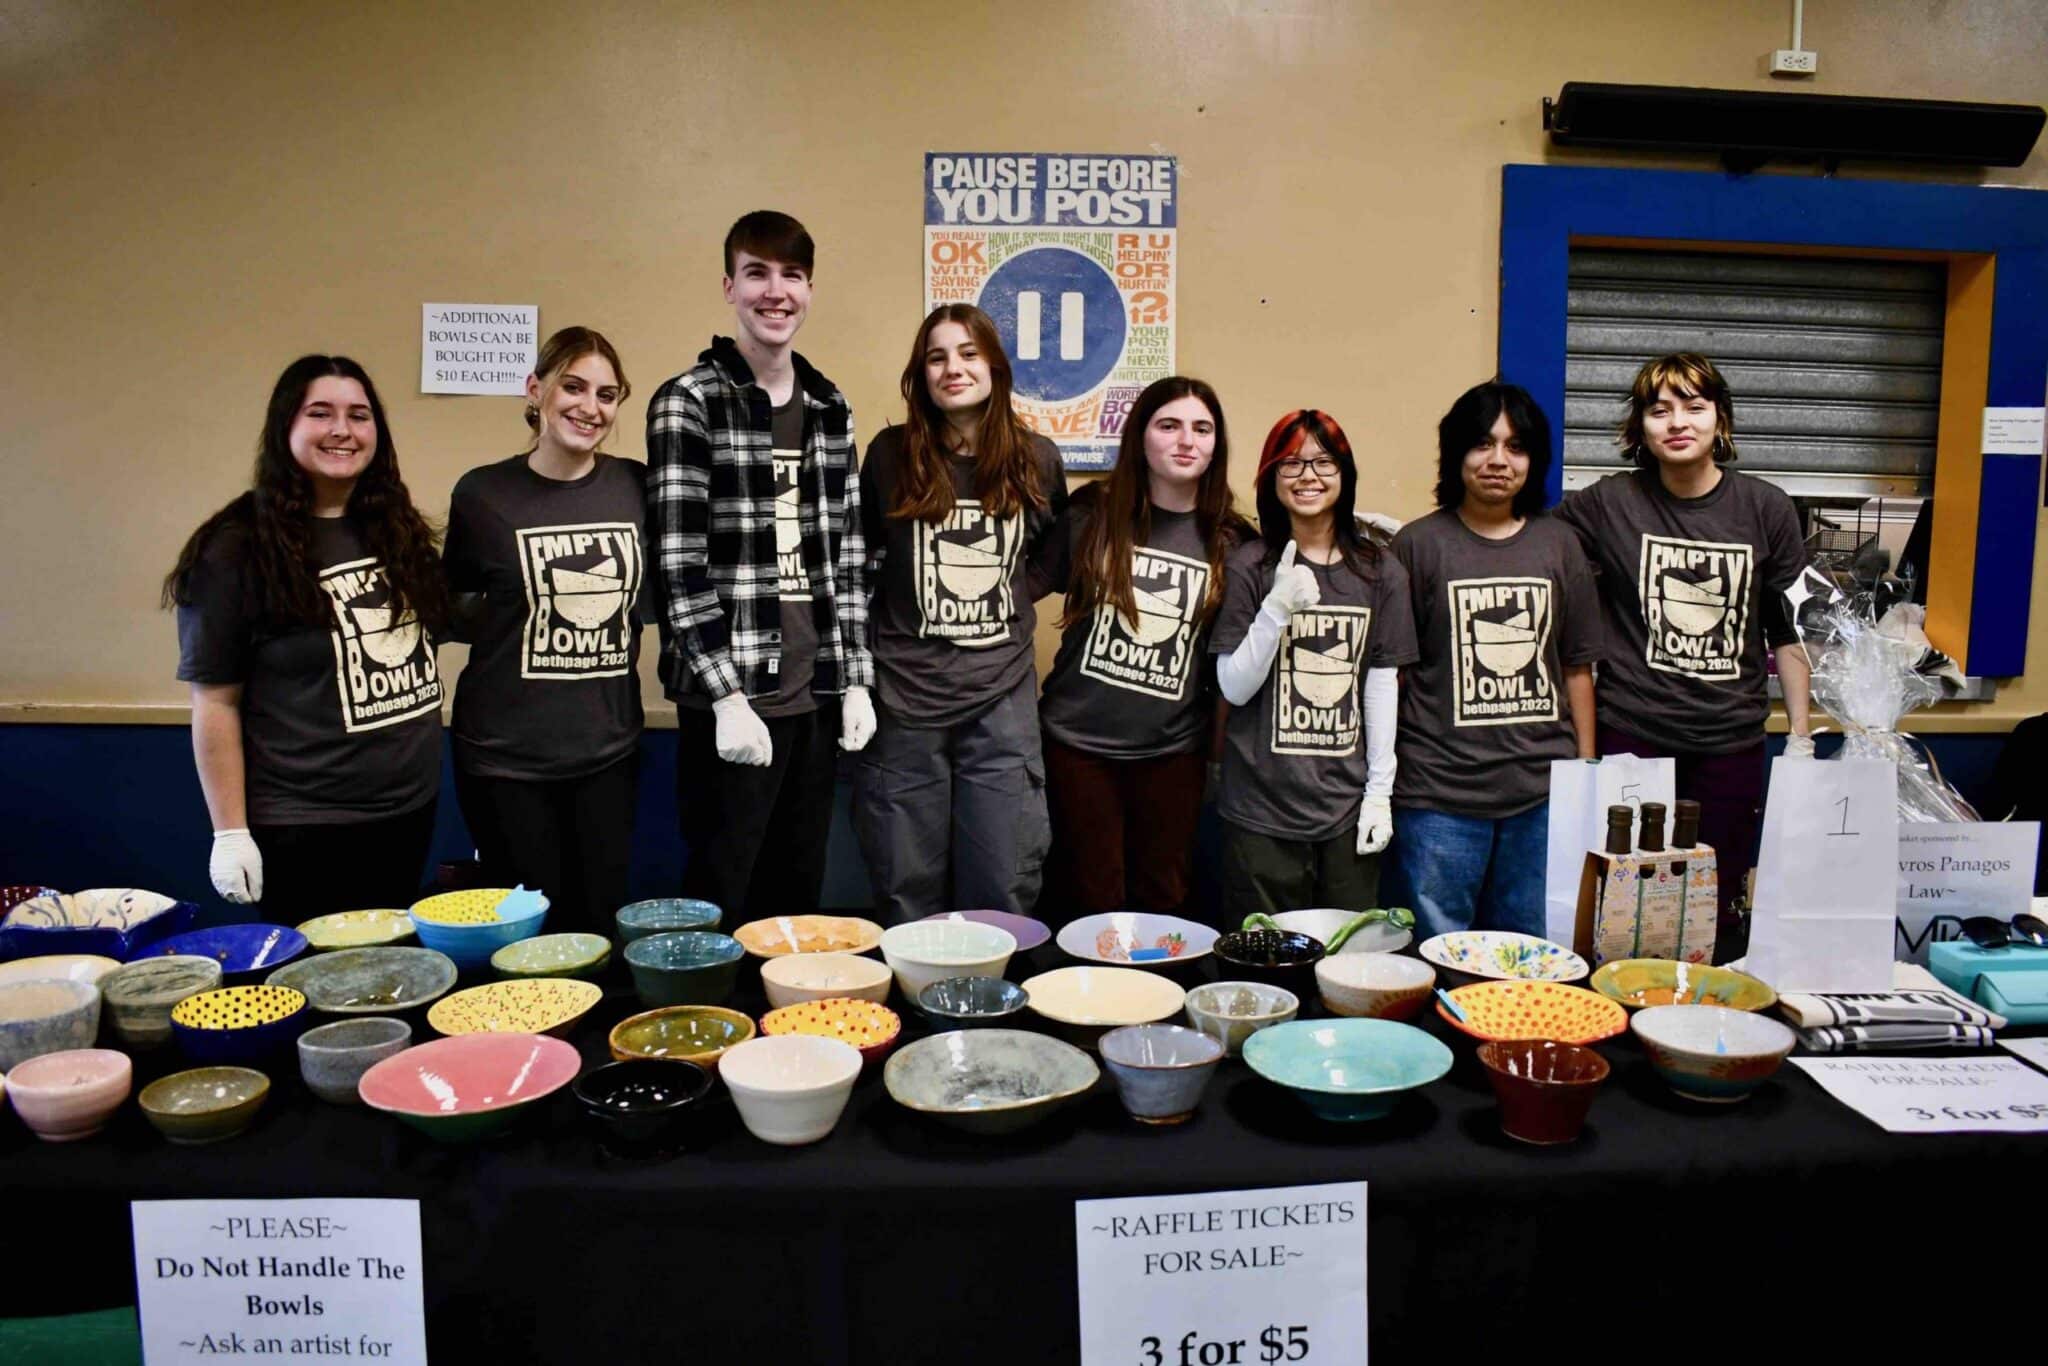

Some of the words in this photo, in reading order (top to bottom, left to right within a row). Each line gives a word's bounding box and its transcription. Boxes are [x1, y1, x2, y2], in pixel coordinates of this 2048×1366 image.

[933, 158, 1037, 188] PAUSE
[1047, 159, 1171, 191] BEFORE
[933, 188, 1032, 223] YOU
[931, 231, 949, 240] YOU
[952, 231, 986, 240] REALLY
[988, 232, 1010, 251] HOW
[1093, 232, 1114, 252] NOT
[1117, 234, 1139, 249] R
[1148, 234, 1170, 249] U
[931, 241, 987, 265] OK
[1117, 250, 1170, 261] HELPIN'
[931, 265, 988, 275] WITH
[1115, 262, 1169, 278] OR
[931, 276, 980, 288] SAYING
[931, 288, 975, 299] THAT?
[431, 311, 531, 325] ~ADDITIONAL
[429, 330, 478, 344] BOWLS
[480, 332, 512, 344] CAN
[515, 333, 533, 344] BE
[1128, 337, 1168, 347] POST
[1131, 327, 1168, 337] YOUR
[435, 350, 496, 363] BOUGHT
[499, 352, 526, 364] FOR
[1127, 355, 1168, 366] NEWS
[436, 369, 458, 382] $10
[529, 531, 634, 596] EMPTY
[1648, 543, 1746, 608] EMPTY
[1131, 553, 1205, 622] MPTY
[1457, 585, 1548, 646] EMPTY
[1647, 598, 1738, 659] BOWLS
[1093, 603, 1191, 676] BOWLS
[346, 624, 437, 704] BOWLS
[532, 654, 598, 668] bethpage
[1707, 657, 1733, 671] 2023
[1089, 655, 1147, 683] bethpage
[1149, 673, 1180, 690] 2023
[1461, 642, 1550, 701] BOWLS
[354, 692, 416, 719] bethpage
[416, 682, 439, 703] 2023
[1463, 700, 1520, 715] bethpage
[1520, 698, 1551, 711] 2023
[1278, 729, 1335, 745] bethpage
[1621, 783, 1641, 819] 5
[1826, 796, 1861, 836] 1
[1897, 860, 1936, 873] vros
[1940, 856, 2011, 877] Panagos
[1908, 884, 1958, 899] Law~
[1920, 1062, 2020, 1072] TICKETS
[1866, 1075, 1919, 1086] FOR
[1905, 1107, 1936, 1120] 3
[1942, 1107, 2008, 1121] for
[2007, 1103, 2048, 1120] $5
[210, 1216, 349, 1239] ~PLEASE~
[1092, 1209, 1224, 1239] ~RAFFLE
[1231, 1201, 1355, 1231] TICKETS
[155, 1257, 194, 1279] Do
[201, 1256, 250, 1278] Not
[257, 1256, 351, 1278] Handle
[357, 1256, 406, 1280] The
[1144, 1251, 1203, 1276] FOR
[1209, 1244, 1305, 1271] SALE~
[246, 1294, 325, 1316] Bowls
[179, 1332, 246, 1355] ~Ask
[252, 1340, 282, 1354] an
[290, 1334, 352, 1356] artist
[358, 1334, 393, 1358] for
[1138, 1335, 1164, 1366] 3
[1177, 1330, 1247, 1366] for
[1259, 1323, 1310, 1366] $5
